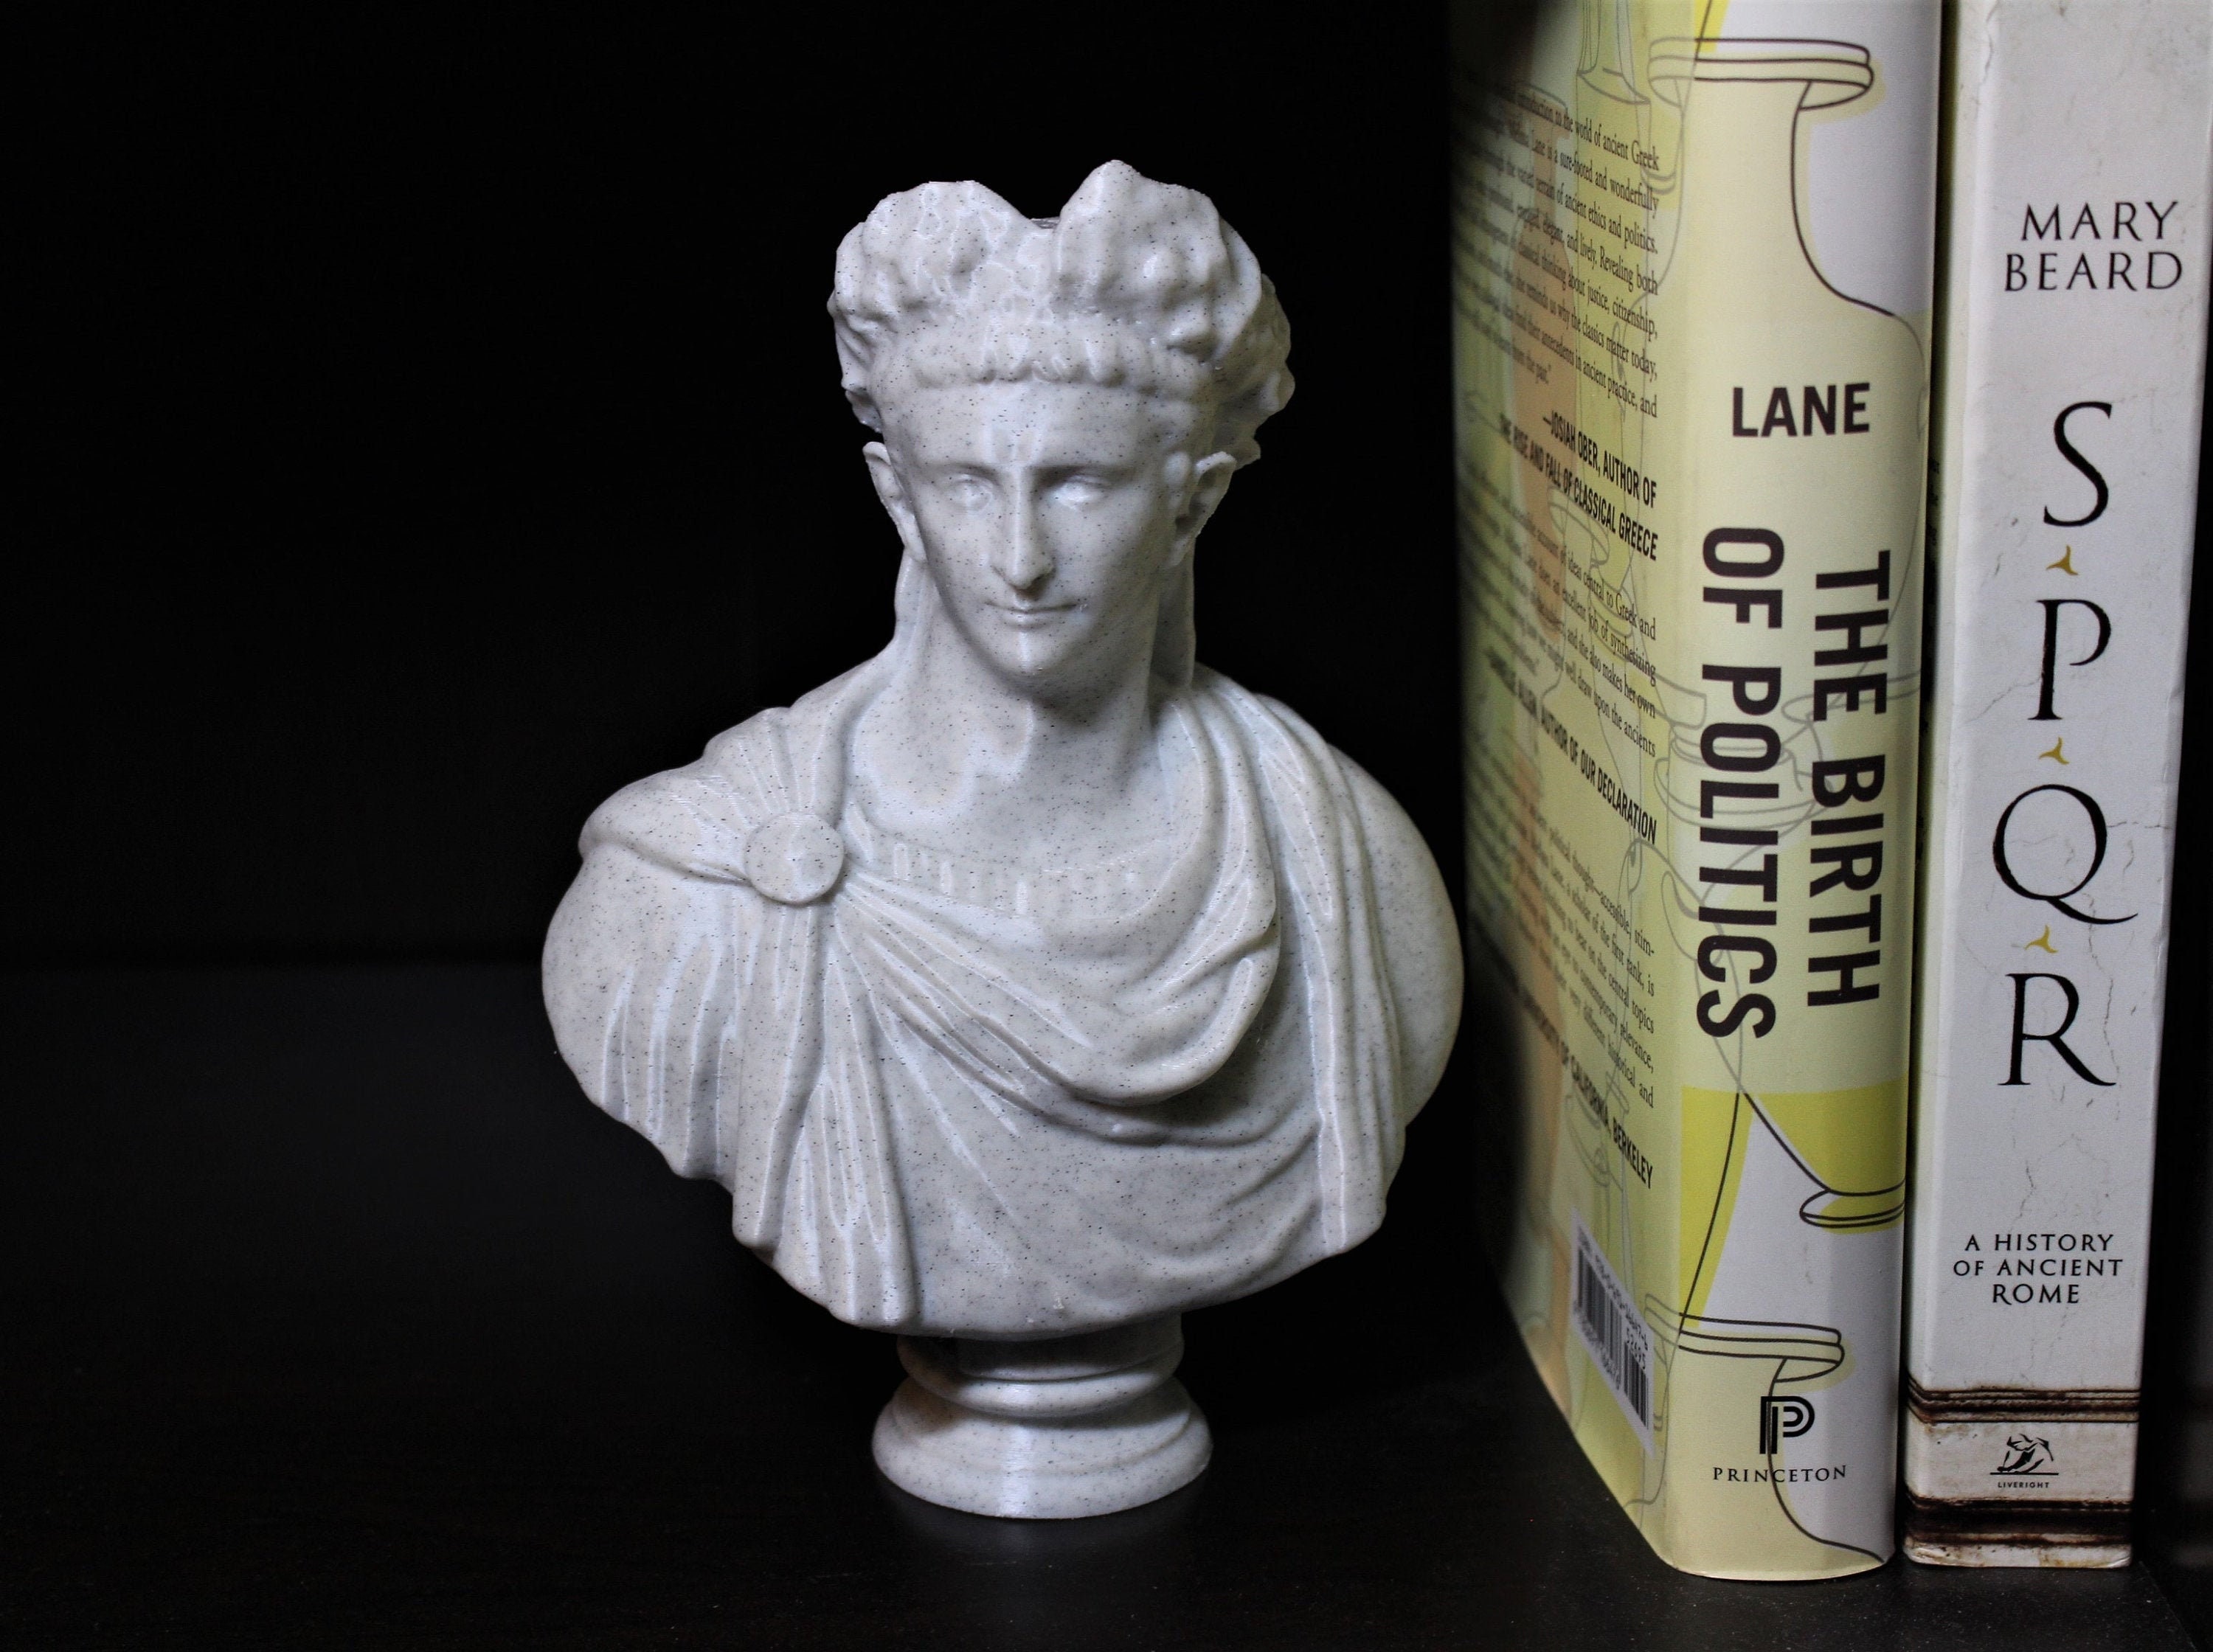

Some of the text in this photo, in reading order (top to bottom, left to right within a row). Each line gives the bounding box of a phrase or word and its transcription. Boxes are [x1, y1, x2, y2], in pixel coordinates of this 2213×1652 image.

[1575, 118, 1592, 142] world
[1594, 124, 1601, 147] of
[1604, 133, 1628, 160] ancient
[1632, 140, 1658, 170] Greek
[1557, 183, 1564, 204] of
[1565, 192, 1586, 218] ancient
[1588, 201, 1606, 229] ethics
[1609, 215, 1621, 237] and
[1624, 222, 1658, 254] politics.
[1560, 150, 1593, 183] sure-footed
[1596, 167, 1607, 190] and
[1610, 178, 1659, 219] wonderfully
[2021, 201, 2178, 241] MARY
[1567, 230, 1578, 252] and
[1581, 233, 1597, 269] lively.
[1600, 246, 1633, 292] Revealing
[1637, 265, 1658, 295] both
[2005, 251, 2182, 291] BEARD
[1568, 267, 1585, 296] about
[1587, 280, 1609, 314] justice,
[1613, 297, 1657, 341] citizenship,
[1572, 307, 1581, 332] the
[1582, 314, 1604, 347] classics
[1607, 337, 1629, 362] matter
[1632, 349, 1657, 383] today,
[1576, 349, 1581, 371] in
[1583, 361, 1606, 388] ancient
[1608, 377, 1637, 411] practice,
[1640, 395, 1657, 417] and
[1733, 383, 1870, 437] LANE
[1579, 431, 1600, 477] OBER,
[1604, 450, 1639, 500] AUTHOR
[1644, 476, 1657, 507] OF
[2043, 400, 2112, 527] S
[1546, 453, 1560, 487] FALL
[1564, 468, 1572, 497] OF
[1574, 477, 1615, 533] CLASSICAL
[1619, 513, 1658, 560] GREECE
[1584, 572, 1604, 600] central
[1607, 591, 1613, 608] to
[1616, 592, 1637, 628] Greek
[1640, 618, 1655, 640] and
[1589, 608, 1599, 633] job
[1601, 620, 1609, 642] of
[1611, 634, 1656, 687] synthesizing
[1590, 645, 1601, 672] also
[1603, 663, 1622, 693] makes
[1624, 674, 1635, 703] her
[1638, 695, 1655, 718] own
[2028, 599, 2111, 721] P
[1594, 691, 1610, 718] upon
[1612, 704, 1621, 729] the
[1624, 721, 1656, 757] ancients
[1570, 736, 1578, 766] OF
[1581, 749, 1596, 788] OUR
[1598, 767, 1657, 844] DECLARATION
[1697, 527, 1784, 1038] OF POLITICS
[1807, 549, 1891, 1007] THE BIRTH
[1992, 783, 2138, 925] Q
[1635, 929, 1654, 957] stim-
[1627, 959, 1644, 990] rank,
[1648, 974, 1654, 996] is
[1621, 1021, 1653, 1073] relevance,
[1632, 1000, 1653, 1033] topics
[1998, 973, 2116, 1086] R
[1639, 1083, 1653, 1108] and
[1613, 1117, 1652, 1189] BERKELEY
[1954, 1259, 2122, 1276] OF ANCIENT
[1964, 1234, 2113, 1252] A HISTORY
[1992, 1284, 2079, 1305] ROME
[1713, 1465, 1846, 1482] PRINCETON
